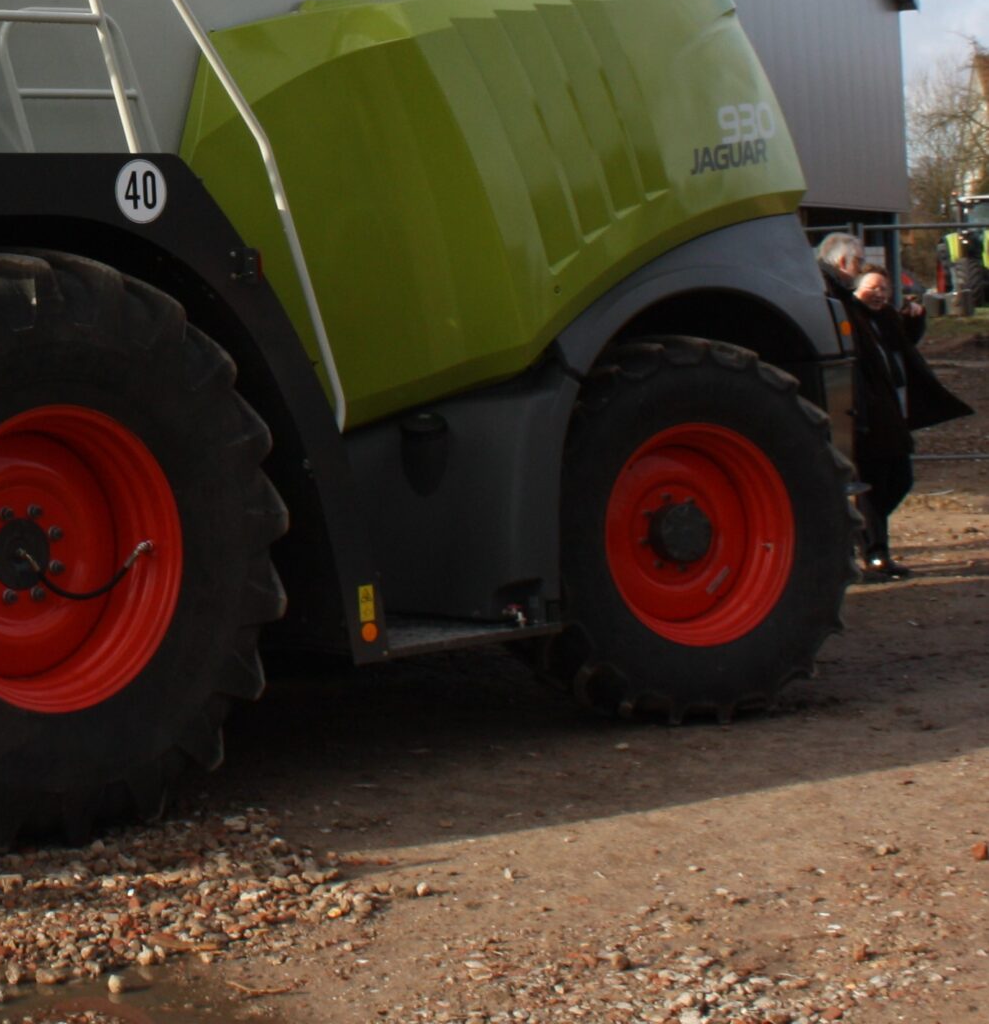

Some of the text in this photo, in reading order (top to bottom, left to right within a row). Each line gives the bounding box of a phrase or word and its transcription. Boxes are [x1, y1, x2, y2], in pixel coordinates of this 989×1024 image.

[717, 101, 775, 144] 930
[690, 138, 768, 175] JAGUAR
[125, 170, 157, 210] 40
